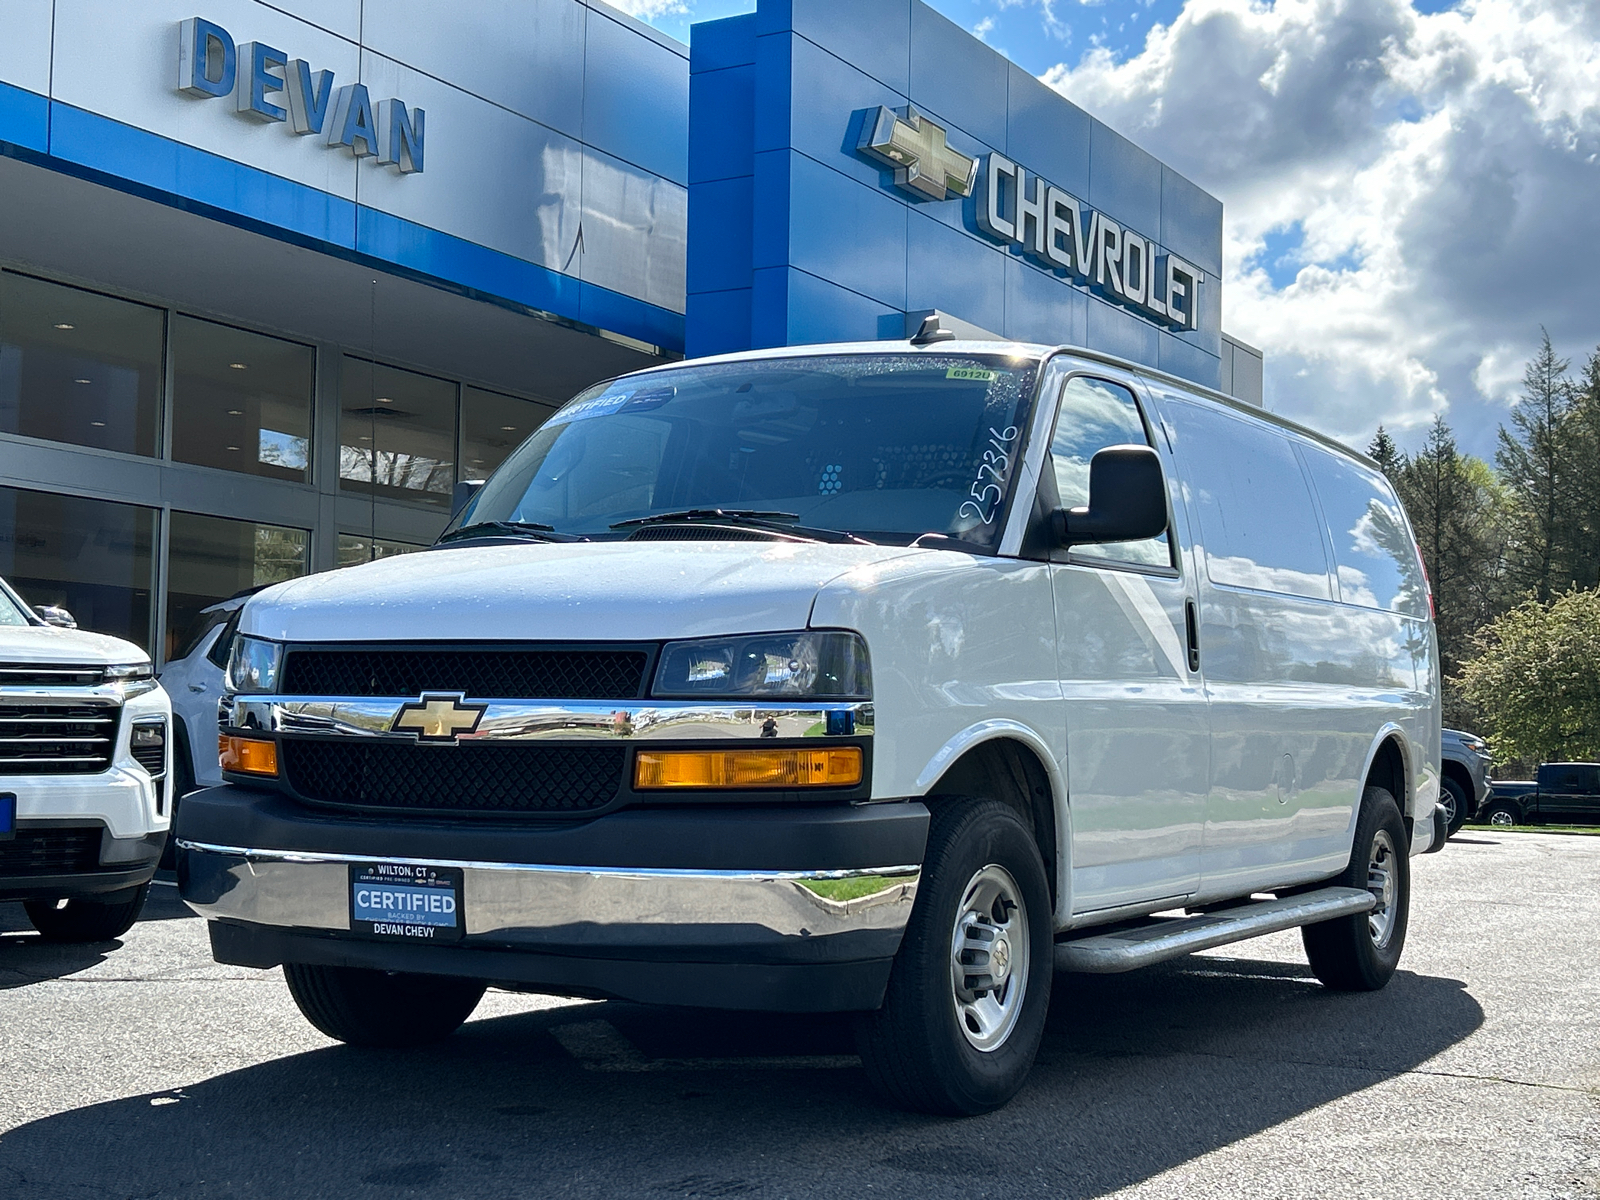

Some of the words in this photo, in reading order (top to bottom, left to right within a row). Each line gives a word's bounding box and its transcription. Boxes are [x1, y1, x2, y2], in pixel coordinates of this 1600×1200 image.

[180, 16, 425, 173] DEVAN
[984, 152, 1204, 331] CHEVROLET
[953, 370, 991, 380] 6912U
[959, 425, 1018, 525] 257316
[377, 864, 414, 877] WILTON,
[415, 867, 428, 878] CT
[357, 890, 456, 914] CERTIFIED
[387, 912, 415, 920] BACKED
[373, 923, 404, 936] DEVAN
[405, 925, 435, 938] CHEVY
